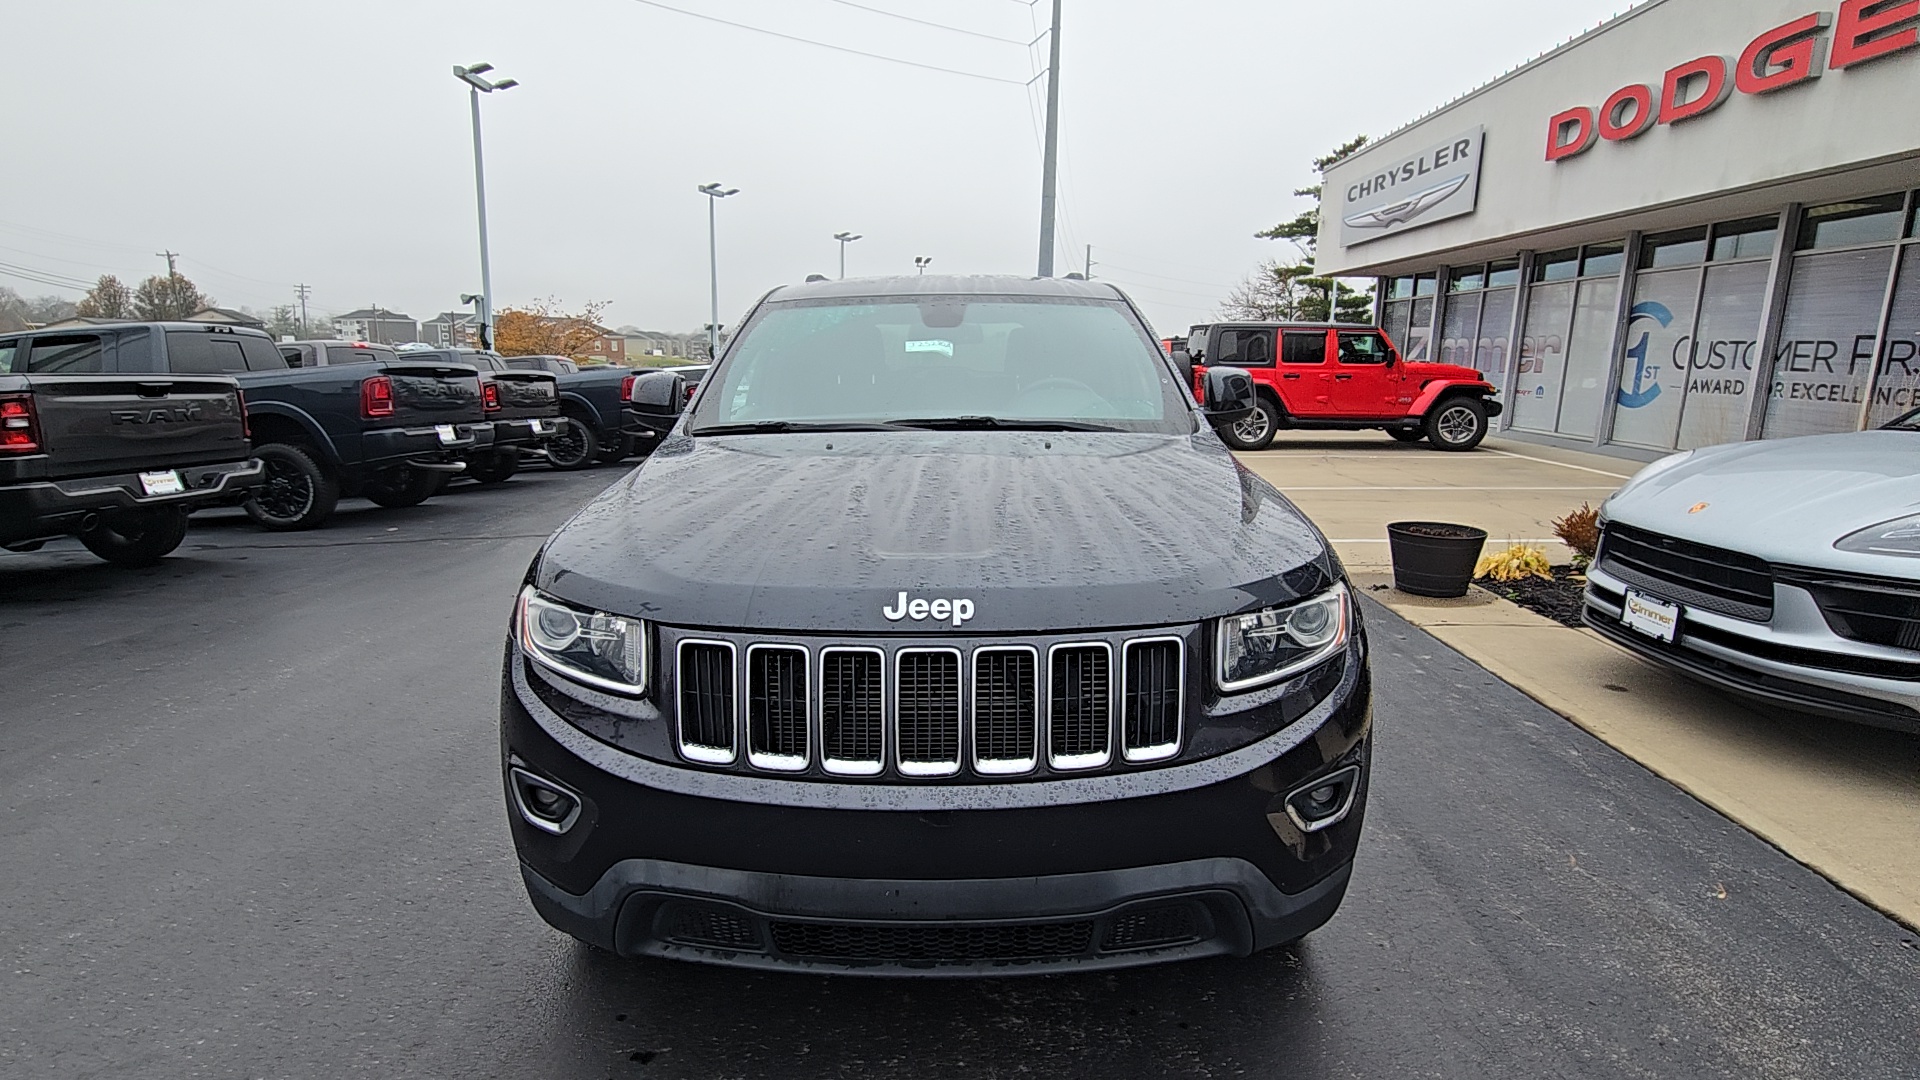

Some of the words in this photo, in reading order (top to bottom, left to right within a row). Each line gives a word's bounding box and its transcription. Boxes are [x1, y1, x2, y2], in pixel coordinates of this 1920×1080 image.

[1545, 0, 1920, 162] DODGE
[1347, 138, 1470, 203] CHRYSLER
[1406, 326, 1562, 374] Zmmer
[1847, 334, 1920, 376] FIR
[1688, 378, 1745, 396] AWARD
[1789, 382, 1920, 407] EXCELLNCE
[110, 407, 202, 426] RAM
[882, 591, 976, 627] Jeep
